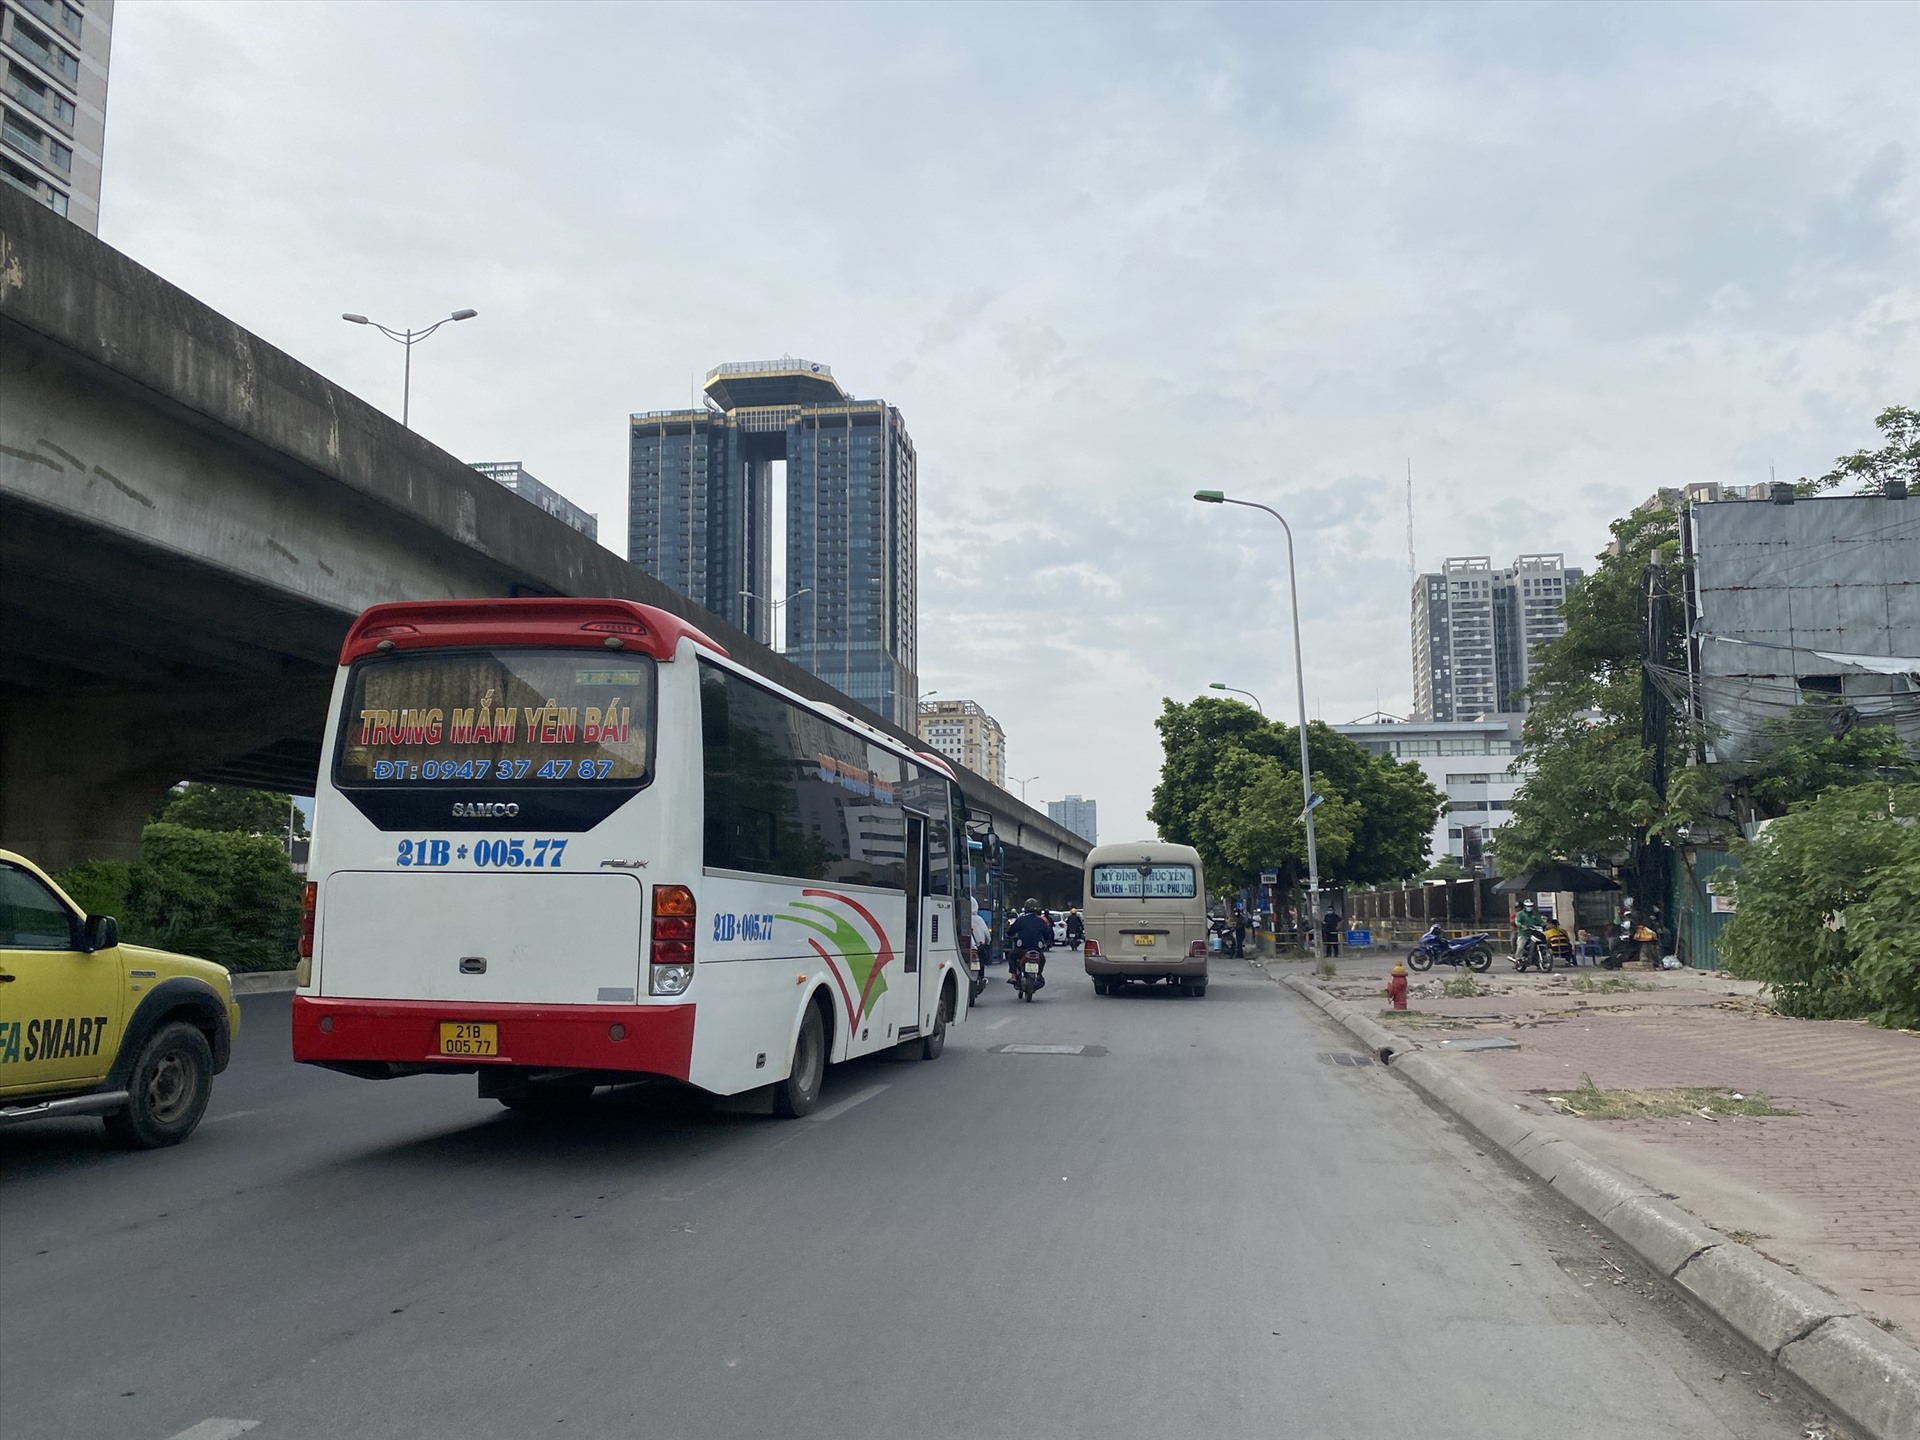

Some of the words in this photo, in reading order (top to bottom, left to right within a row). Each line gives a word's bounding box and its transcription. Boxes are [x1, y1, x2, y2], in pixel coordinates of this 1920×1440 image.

[360, 708, 444, 745] TRUNG
[524, 698, 578, 744] YÊN
[582, 697, 631, 744] BÁI
[495, 760, 532, 780] 37
[537, 760, 573, 780] 47
[577, 760, 615, 780] 87
[452, 802, 520, 818] SAMCO
[396, 838, 451, 867] 21B
[473, 838, 569, 868] 005.77
[713, 913, 735, 942] 21B
[742, 913, 773, 941] 005.77
[24, 1016, 108, 1062] SMART
[456, 1025, 481, 1038] 21B
[446, 1039, 491, 1053] 005.77
